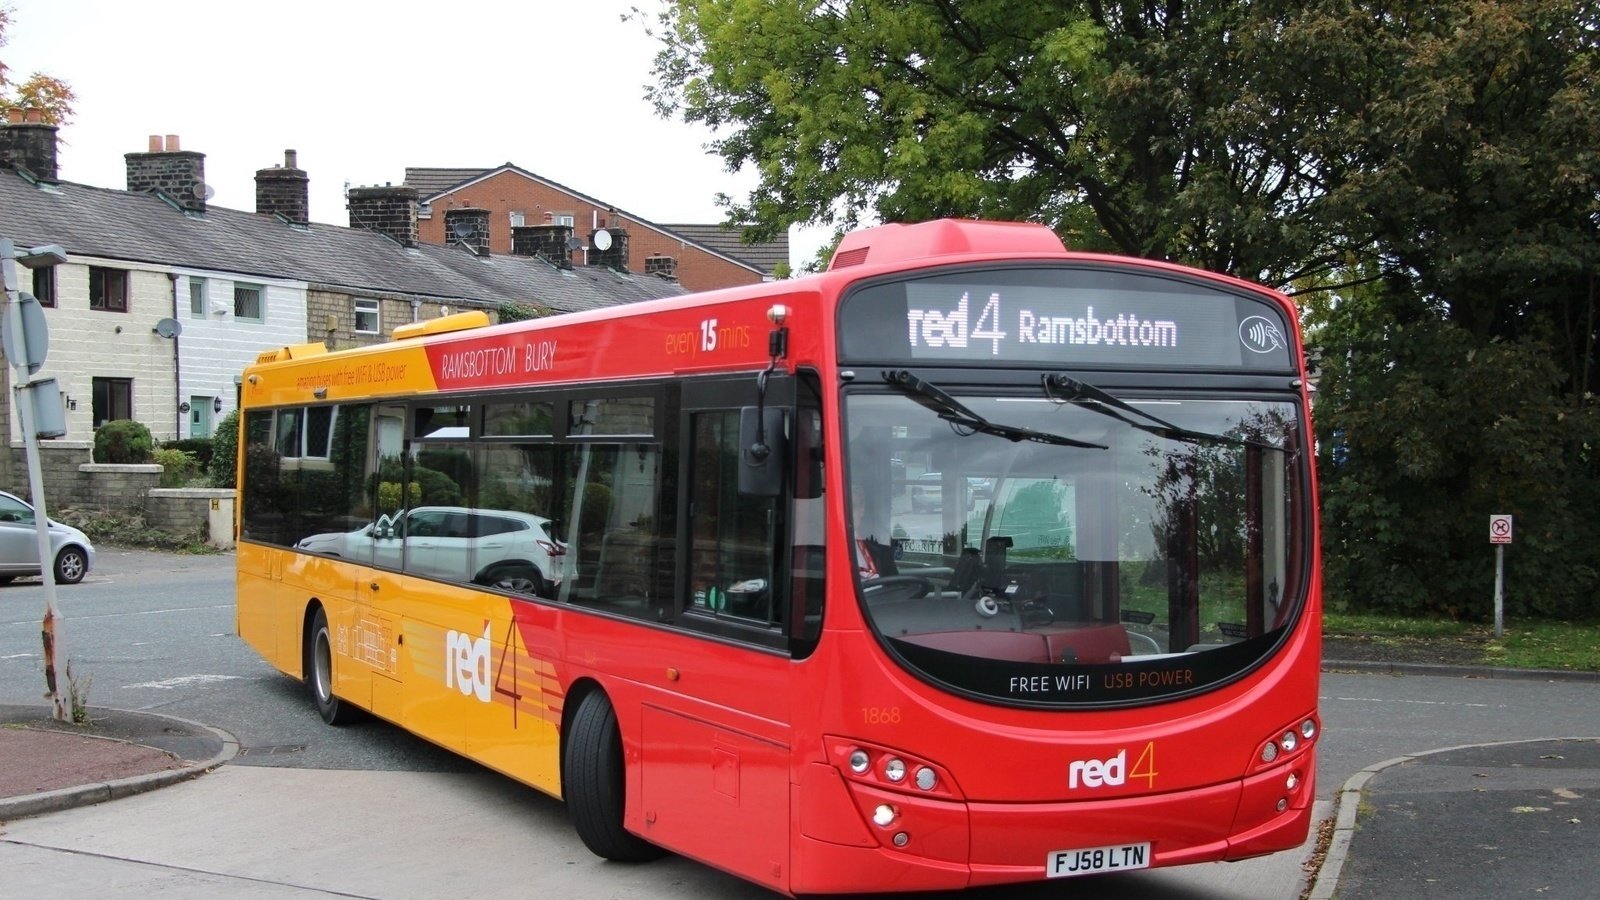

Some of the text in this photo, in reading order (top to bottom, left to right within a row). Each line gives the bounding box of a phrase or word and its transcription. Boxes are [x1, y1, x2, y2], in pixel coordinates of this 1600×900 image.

[665, 319, 750, 359] every 15 mins
[907, 291, 1177, 355] red 4 Ramsbottom
[373, 362, 386, 383] USB
[386, 363, 407, 384] power
[442, 340, 558, 379] RAMSBOTTOM BURY
[446, 615, 522, 729] red 4
[1010, 669, 1193, 692] FREE WIFI USB POWER
[861, 706, 901, 724] 1868
[1069, 741, 1159, 789] red 4
[1055, 845, 1144, 873] FJ58 LTN
